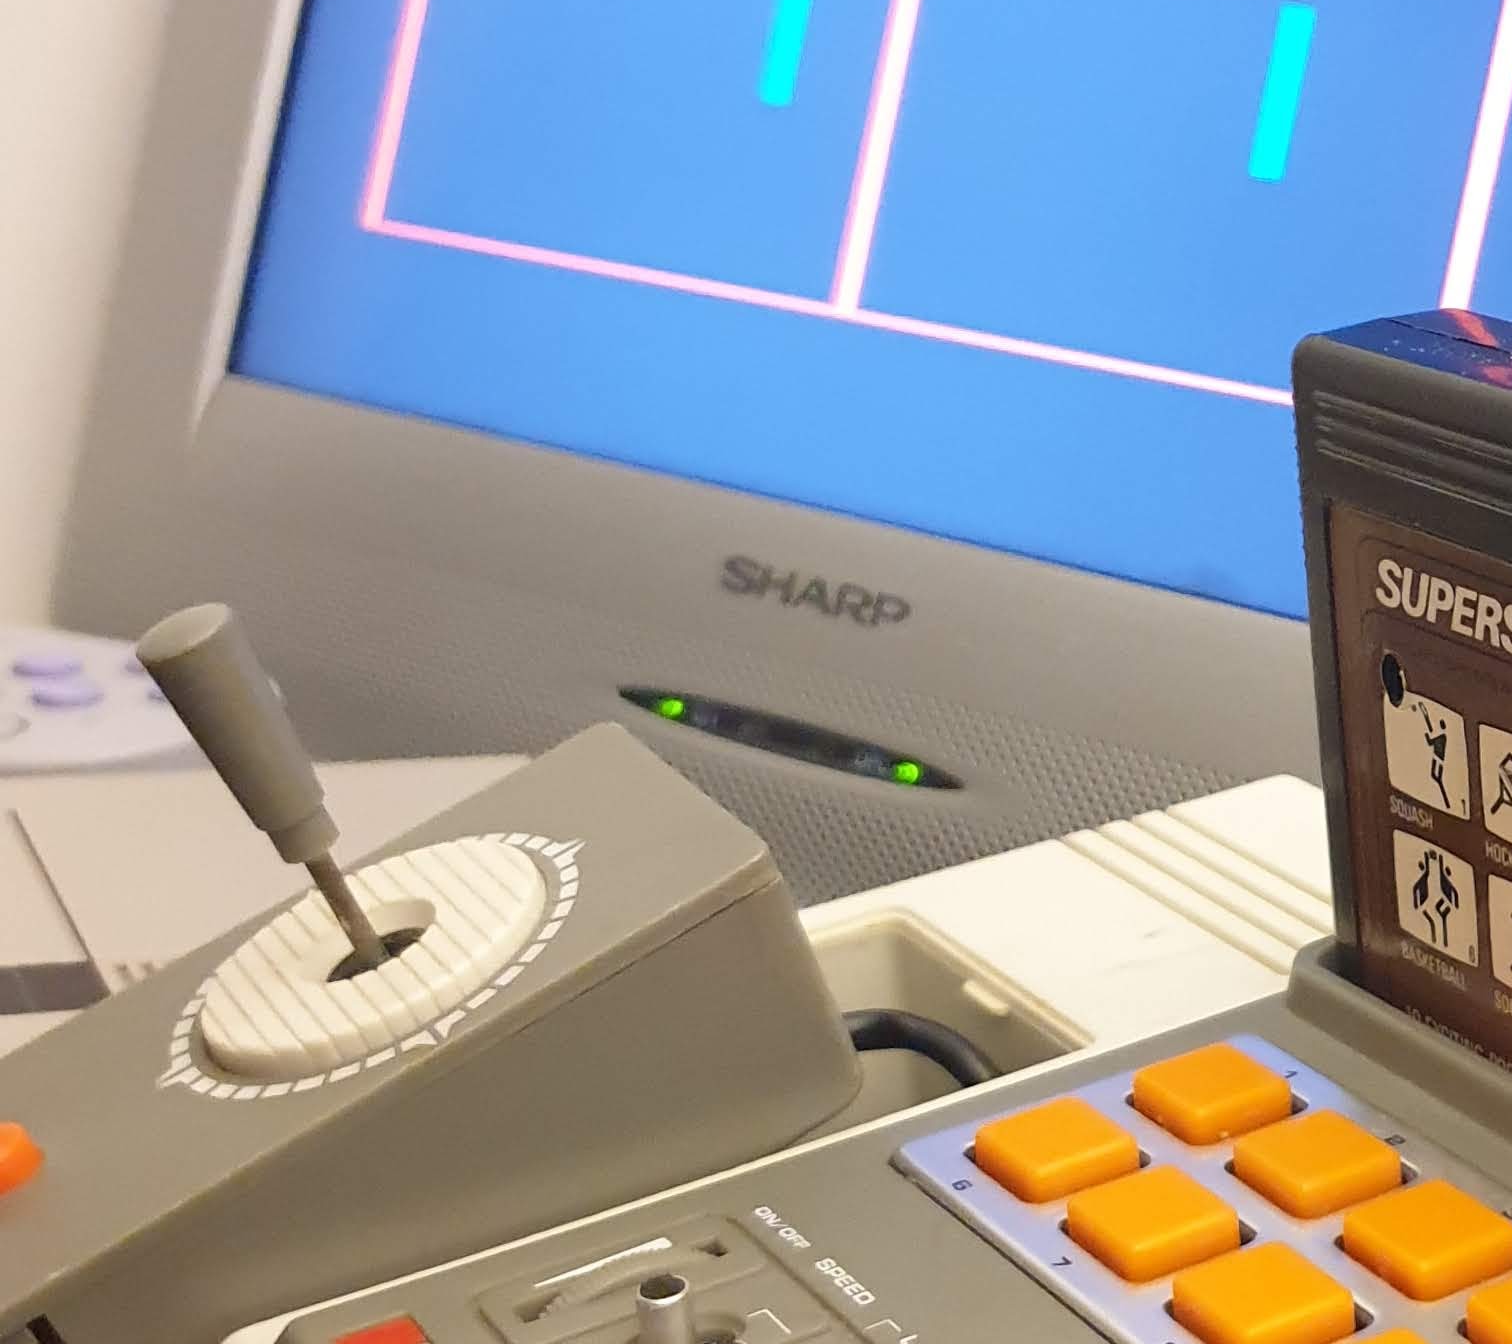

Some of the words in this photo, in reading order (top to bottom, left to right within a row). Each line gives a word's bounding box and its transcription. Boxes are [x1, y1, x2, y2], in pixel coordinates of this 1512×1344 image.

[719, 554, 912, 628] SHARP
[1389, 794, 1434, 830] SQUASH
[1400, 940, 1466, 991] BASKETBALL
[1384, 1133, 1407, 1147] 2
[951, 1178, 973, 1193] 6
[754, 1205, 812, 1249] ON/OFF
[815, 1257, 876, 1306] SPEED
[1051, 1256, 1073, 1273] 7
